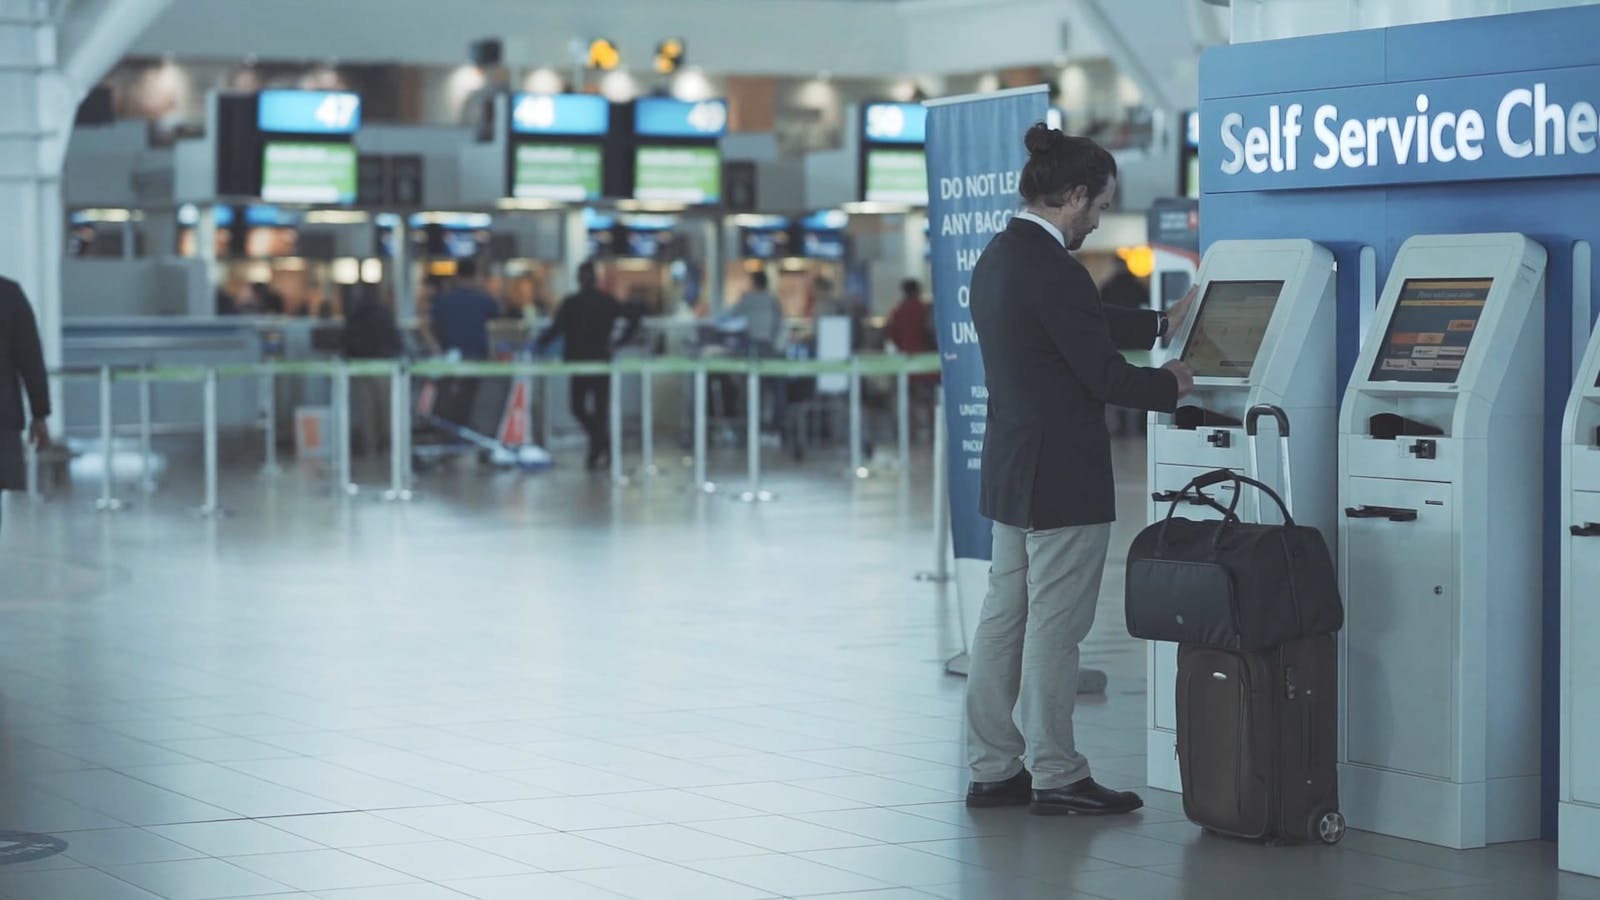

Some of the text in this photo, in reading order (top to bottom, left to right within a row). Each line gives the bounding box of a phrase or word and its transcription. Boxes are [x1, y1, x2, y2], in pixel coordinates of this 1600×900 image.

[1220, 83, 1600, 175] Self Service Che
[940, 176, 963, 200] DO
[965, 173, 997, 197] NOT
[941, 208, 1019, 236] ANY BAGG
